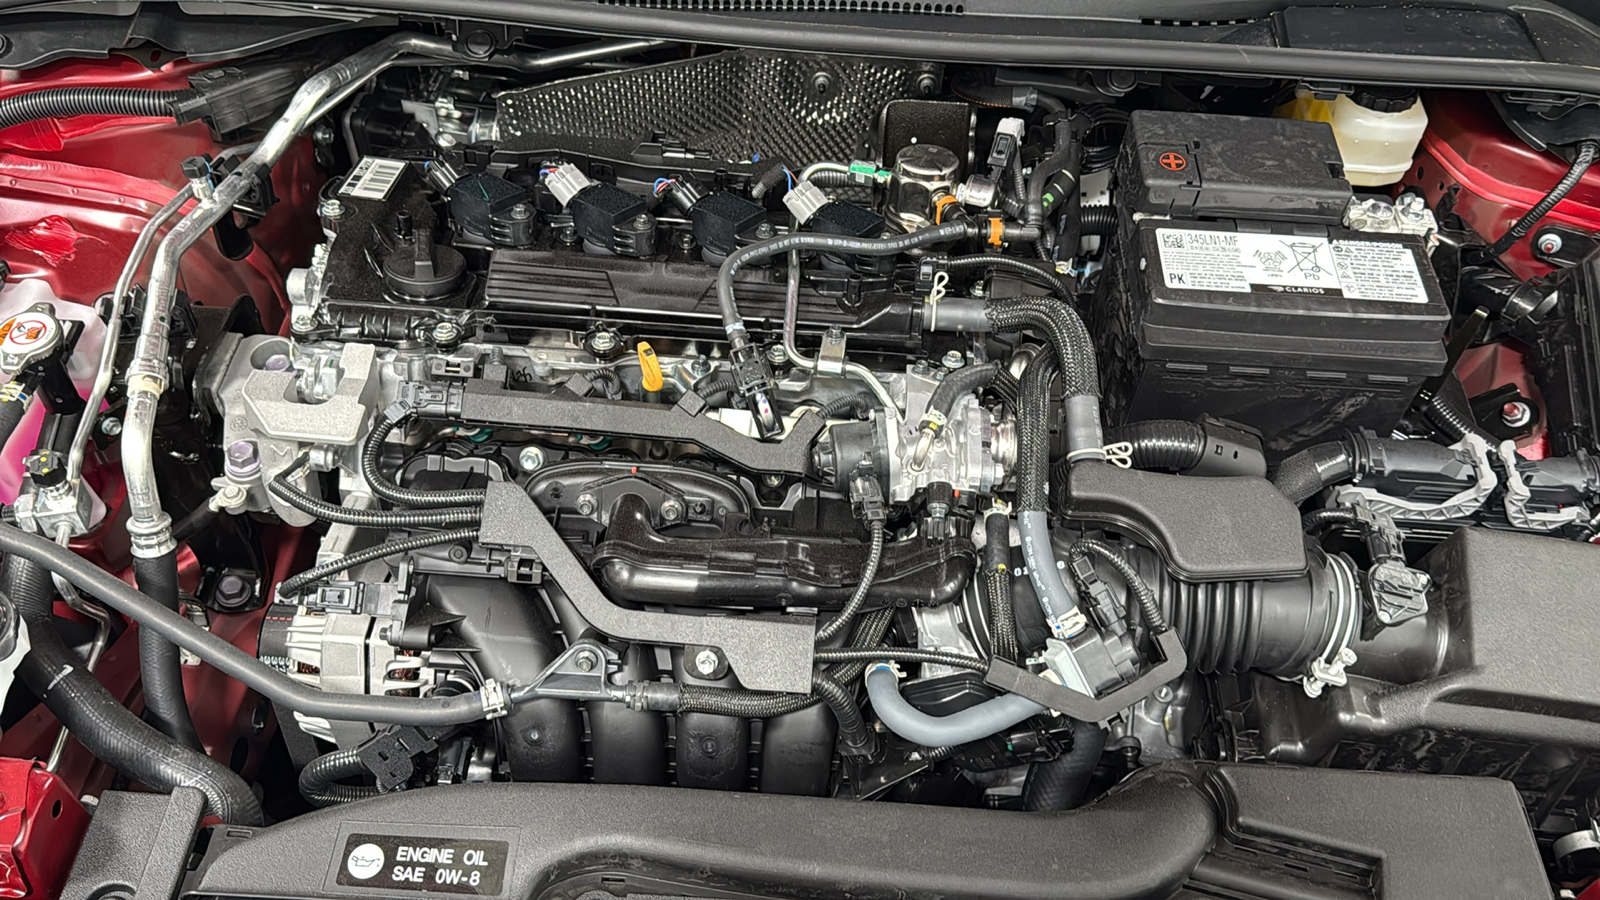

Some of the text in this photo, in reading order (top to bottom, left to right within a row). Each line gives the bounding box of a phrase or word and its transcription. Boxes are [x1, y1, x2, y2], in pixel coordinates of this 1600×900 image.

[1187, 233, 1238, 247] 345LN1-MF
[1169, 273, 1186, 285] PK
[1304, 272, 1321, 281] Pb
[1285, 286, 1325, 294] CLARIOS
[396, 846, 489, 867] ENGINE OIL
[392, 866, 481, 886] SAE 0W-8
